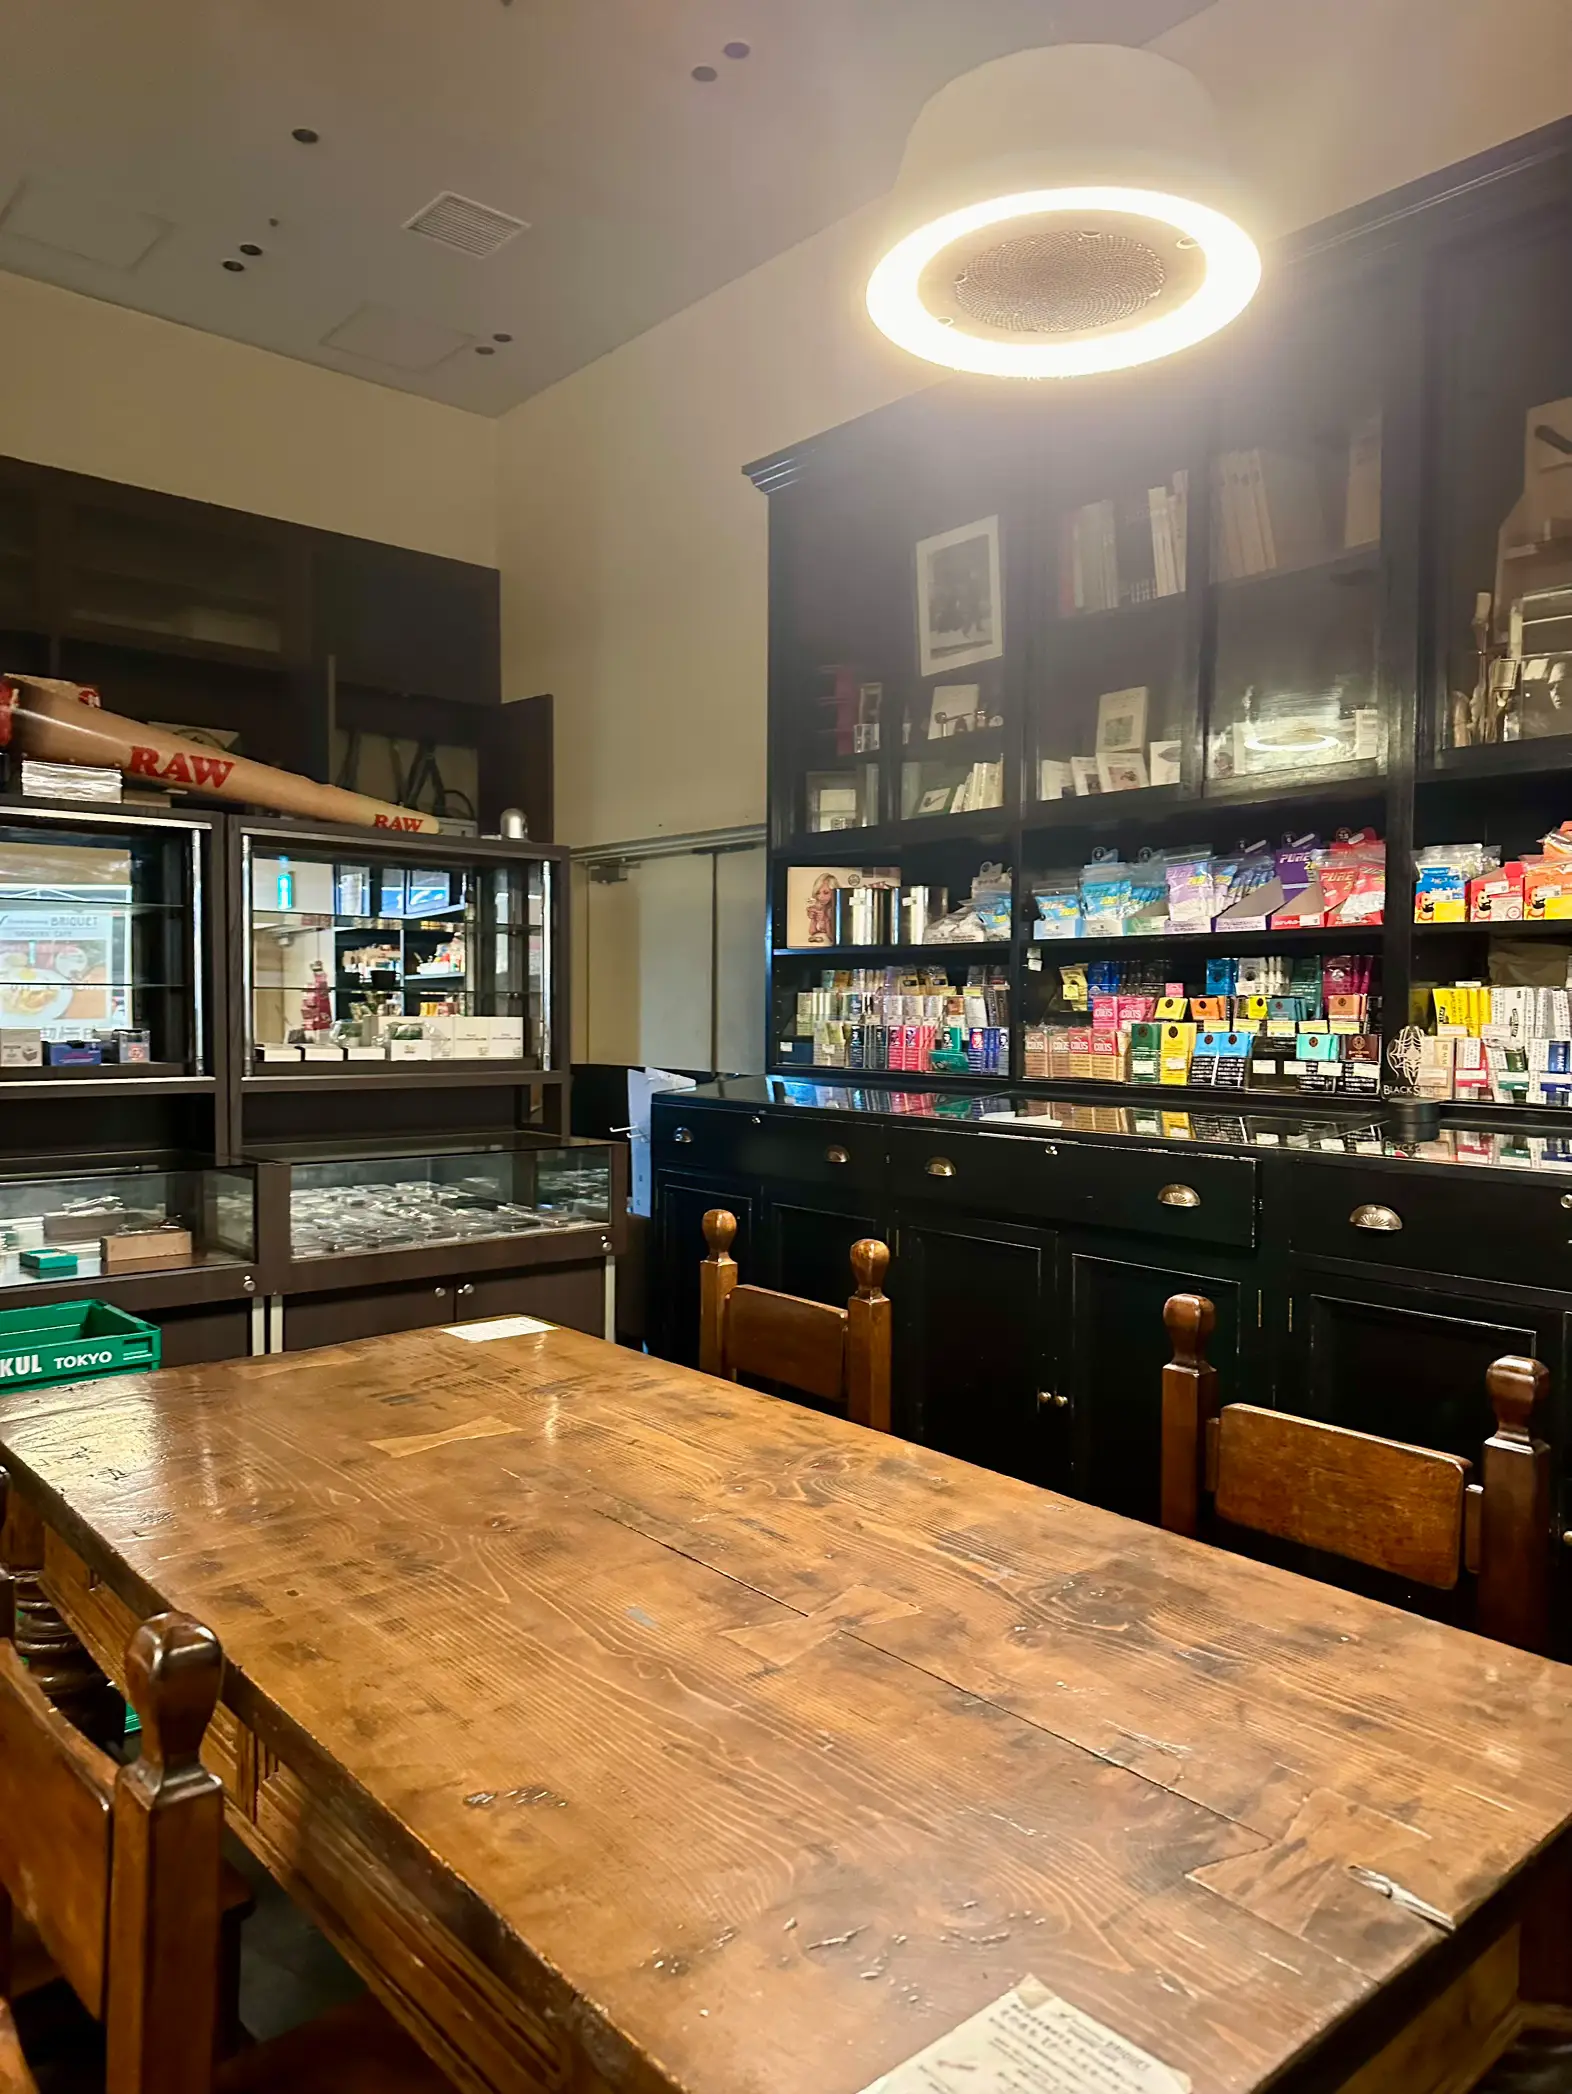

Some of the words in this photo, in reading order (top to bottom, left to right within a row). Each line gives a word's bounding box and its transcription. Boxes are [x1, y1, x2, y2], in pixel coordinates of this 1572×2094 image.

[129, 746, 236, 788] RAW
[373, 813, 424, 833] RAW
[1279, 851, 1311, 864] PURE
[1320, 871, 1354, 882] PURE
[0, 1354, 43, 1378] KUL
[53, 1350, 113, 1370] TOKYO
